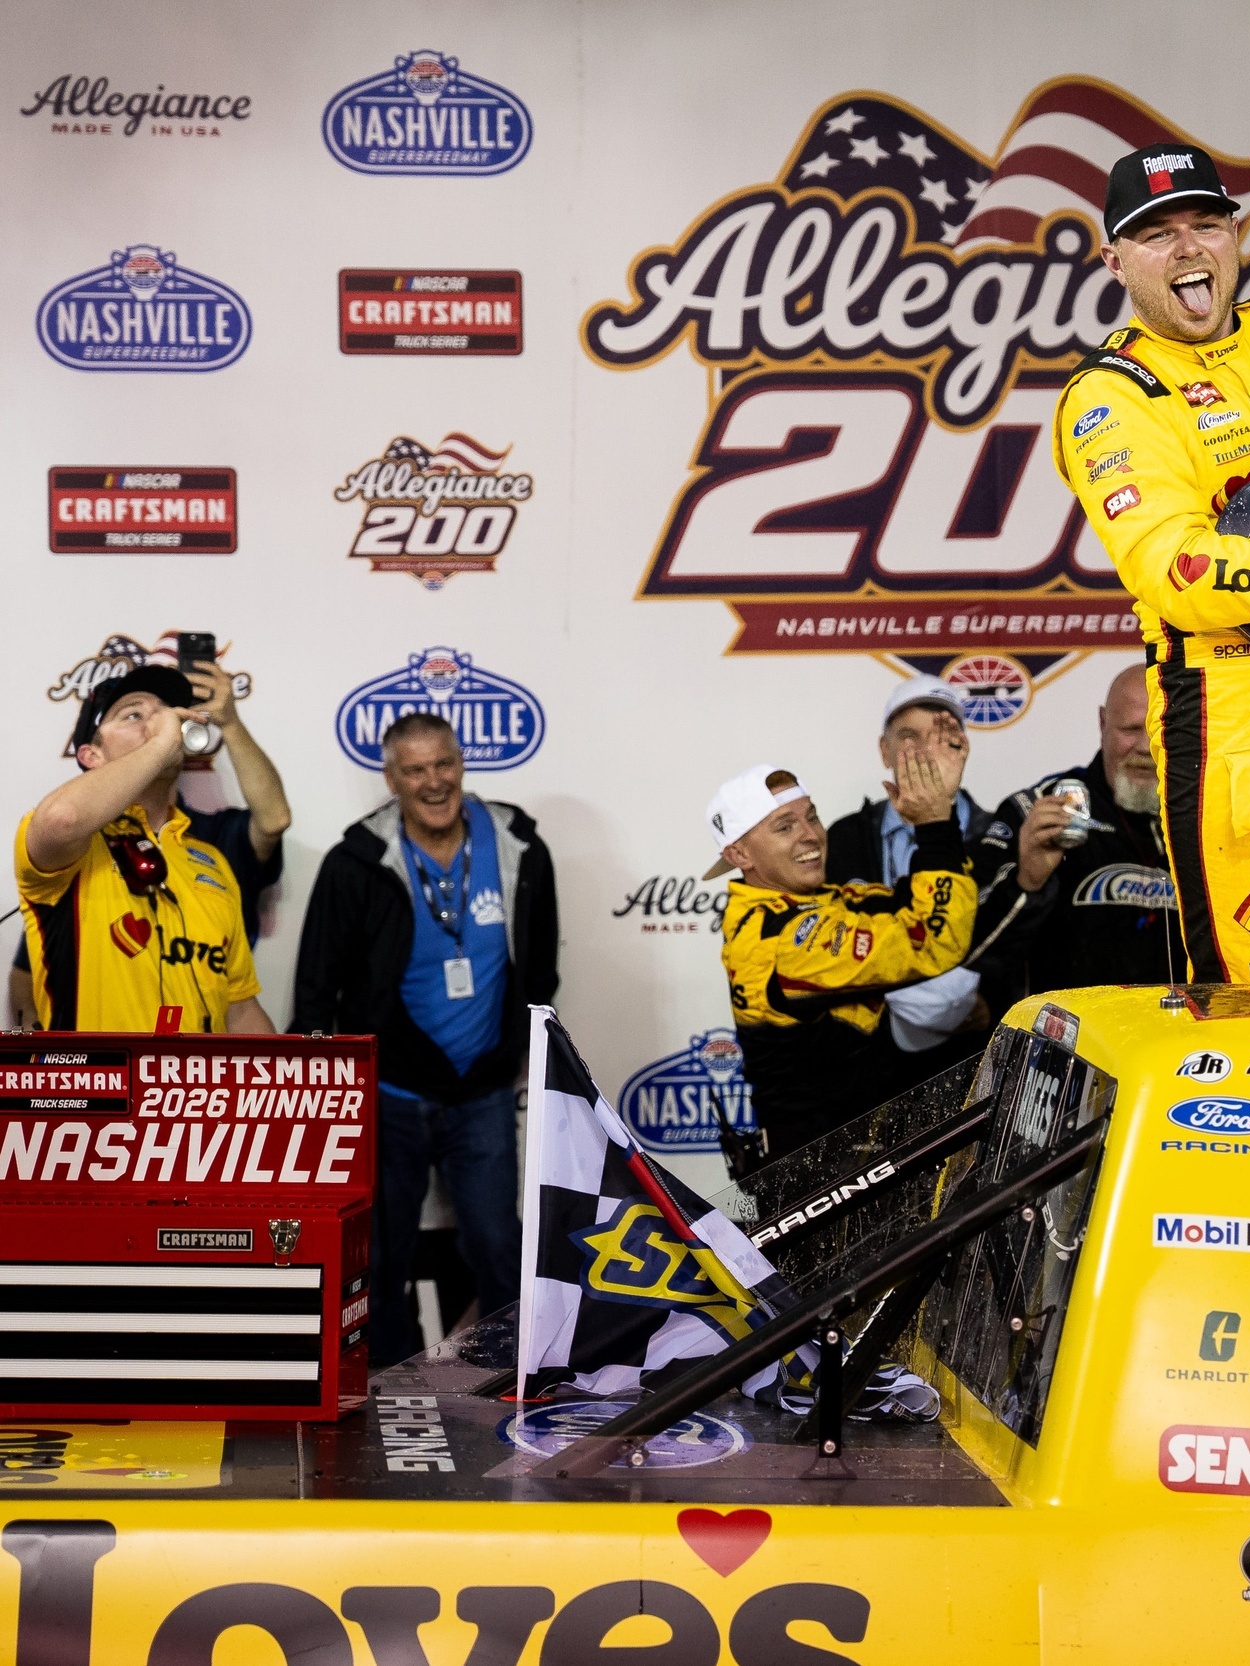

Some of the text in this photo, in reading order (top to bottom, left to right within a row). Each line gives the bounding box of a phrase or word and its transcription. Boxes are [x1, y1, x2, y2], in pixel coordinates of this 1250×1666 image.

[20, 74, 252, 137] Allegiance
[51, 123, 221, 138] MADE IN USA
[342, 104, 514, 151] NASHVILLE
[1142, 153, 1194, 175] Fleetguard
[57, 302, 234, 346] NASHVILLE
[348, 301, 512, 325] CRAFTSMAN
[1099, 356, 1157, 387] sparco
[1075, 420, 1120, 454] RACING
[1078, 410, 1104, 436] Ford
[1088, 449, 1129, 485] SUNOCO
[336, 461, 531, 516] Allegiance
[667, 389, 1122, 577] 20
[58, 497, 227, 523] CRAFTSMAN
[1107, 488, 1137, 515] SEM
[351, 505, 514, 555] 200
[776, 613, 1142, 637] NASHVILLE SUPERSPEED
[355, 702, 526, 744] NAVILLE
[641, 922, 698, 934] MADE
[43, 1053, 88, 1065] NASCAR
[138, 1054, 355, 1086] CRAFTSMAN
[0, 1071, 122, 1090] RAFTSMAN
[30, 1099, 88, 1109] TRUCK SERIES
[138, 1088, 364, 1120] 2026 WINNER
[0, 1121, 363, 1184] NASHVILLE
[750, 1160, 897, 1249] RACING
[162, 1233, 248, 1248] CRAFTSMAN
[1156, 1217, 1240, 1246] Mobil
